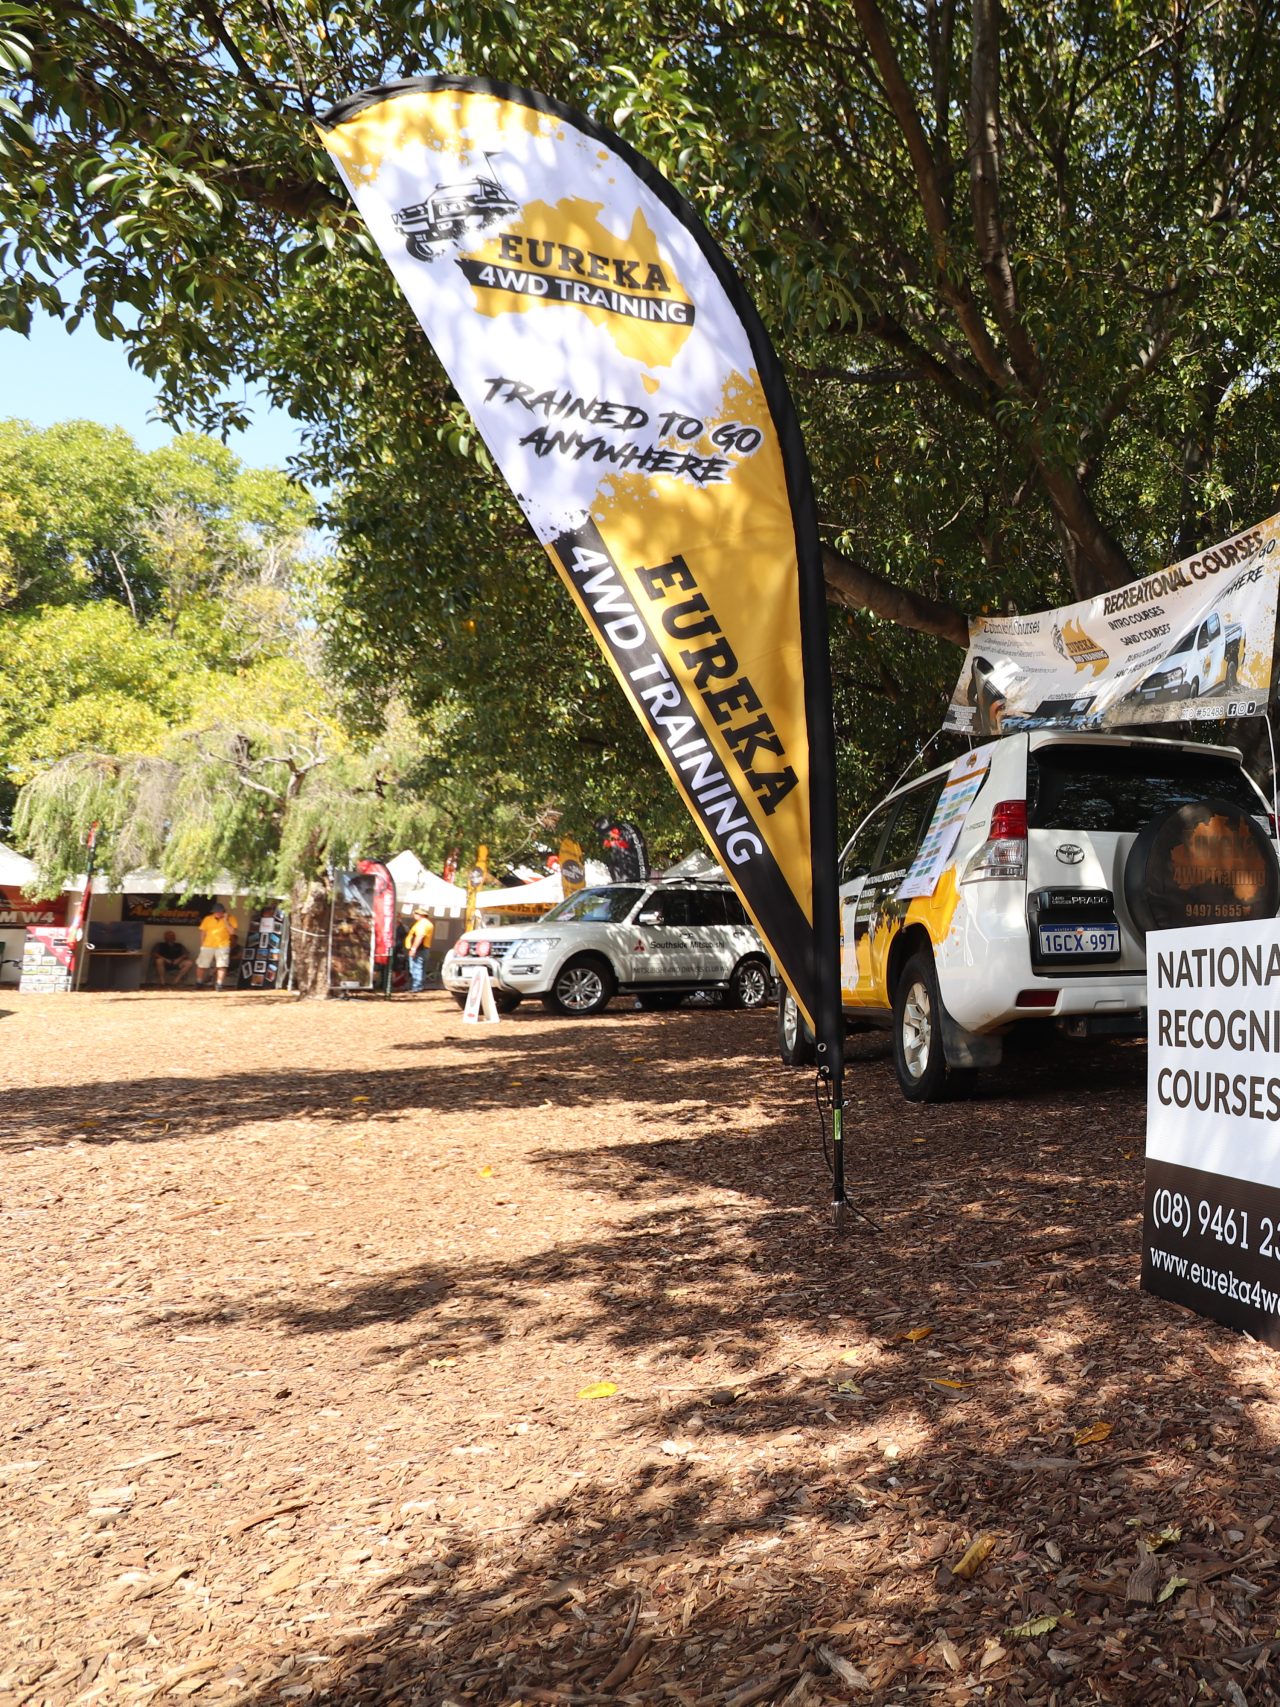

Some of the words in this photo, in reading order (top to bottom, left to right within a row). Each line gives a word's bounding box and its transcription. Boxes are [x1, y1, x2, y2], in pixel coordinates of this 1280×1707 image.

[499, 233, 671, 293] EUREKA
[478, 265, 549, 297] 4WD
[555, 279, 687, 324] TRAINING
[484, 376, 650, 431] TRAINED
[657, 410, 704, 441] TO
[711, 424, 763, 454] GO
[519, 425, 733, 485] ANYWHERE
[1103, 566, 1193, 617] RECREATIONAL
[1190, 530, 1265, 581] COURSES
[1065, 638, 1098, 654] EUREKA
[1108, 616, 1131, 631] INTRO
[1130, 605, 1166, 627] COURSES
[1120, 633, 1141, 646] SAND
[1140, 622, 1172, 641] COURSES
[571, 546, 647, 650] 4WD
[629, 653, 764, 865] TRAINING
[634, 554, 800, 817] EUREKA
[1072, 896, 1109, 905] PRADO
[1185, 904, 1213, 917] 9497
[1214, 904, 1243, 918] 5655
[650, 941, 688, 950] Southside
[1153, 1188, 1191, 1237] (08)
[1198, 1200, 1249, 1249] 9461
